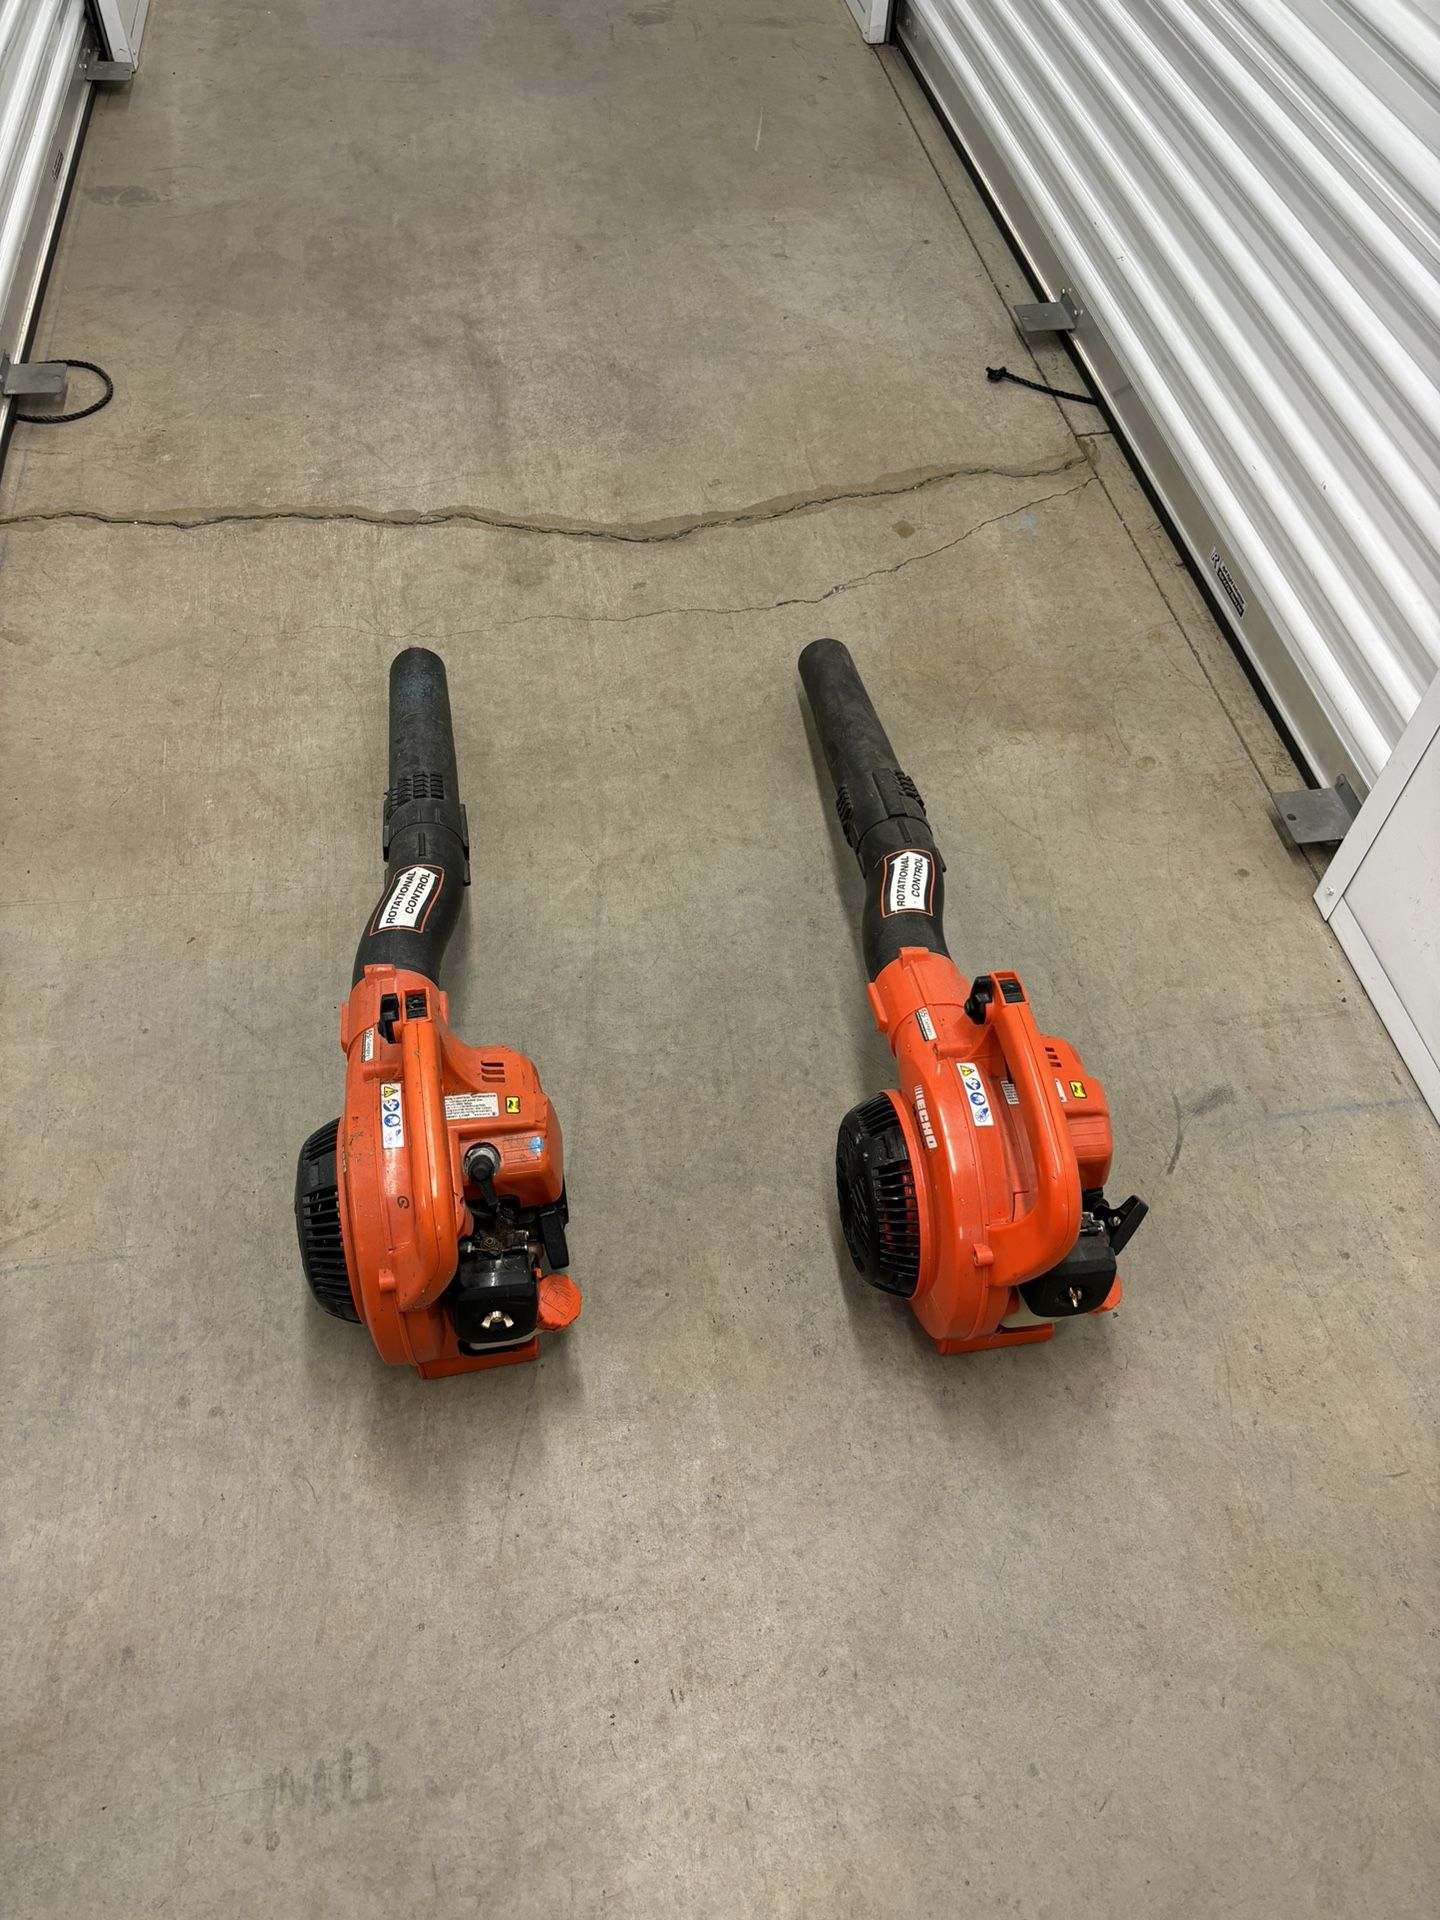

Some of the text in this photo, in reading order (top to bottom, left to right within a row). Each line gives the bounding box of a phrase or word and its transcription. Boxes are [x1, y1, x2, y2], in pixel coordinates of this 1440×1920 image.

[385, 871, 417, 924] ROTATIONAL
[404, 872, 431, 915] CONTROL
[896, 855, 910, 907] ROTATIONAL
[911, 857, 923, 898] CONTROL
[917, 1102, 938, 1149] ECHO
